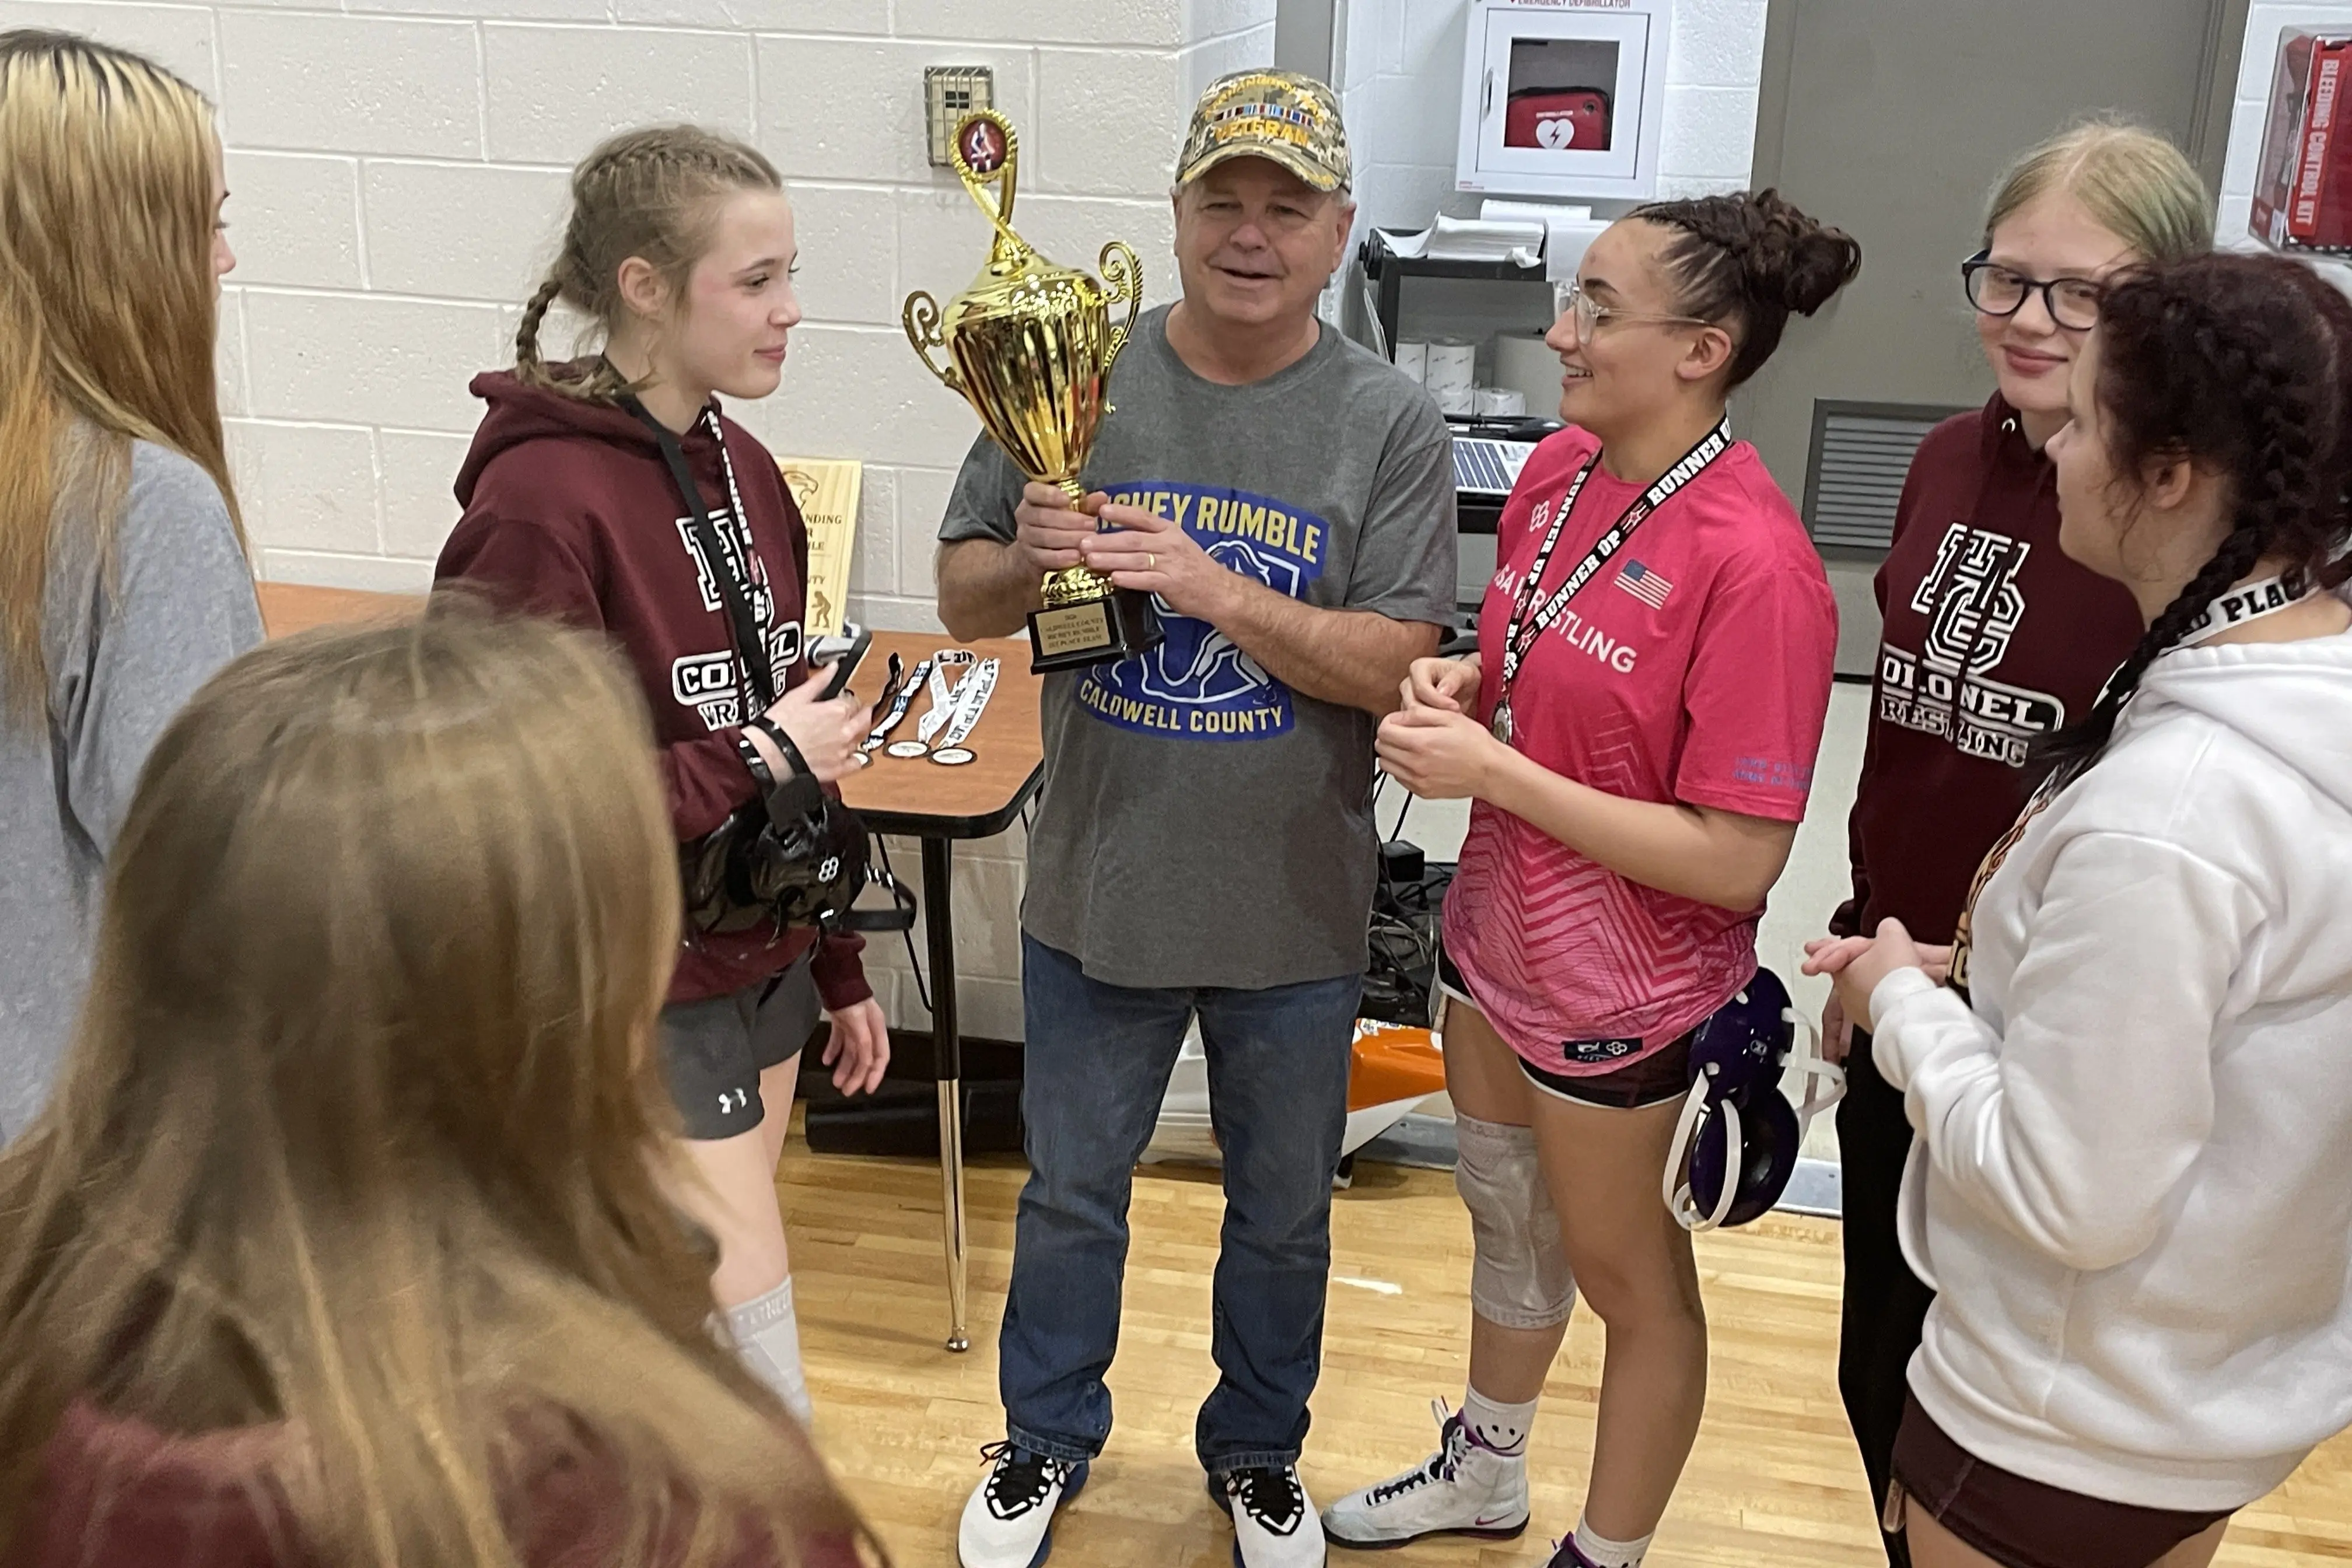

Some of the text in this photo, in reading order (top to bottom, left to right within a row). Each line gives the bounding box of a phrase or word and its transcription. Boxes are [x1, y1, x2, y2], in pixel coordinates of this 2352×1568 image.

[1214, 119, 1309, 146] VETERAN
[2295, 59, 2339, 226] BLEEDING CONTROL KIT
[1647, 417, 1731, 507] RUNNER U
[1196, 496, 1321, 565] RUMBLE
[1541, 470, 1588, 554] RUNNER
[1535, 530, 1620, 629] RUNNER UP
[1513, 576, 1638, 673] RSTLING
[1079, 678, 1282, 733] CALDWELL COUNTY
[1882, 656, 2045, 730] OLONEL
